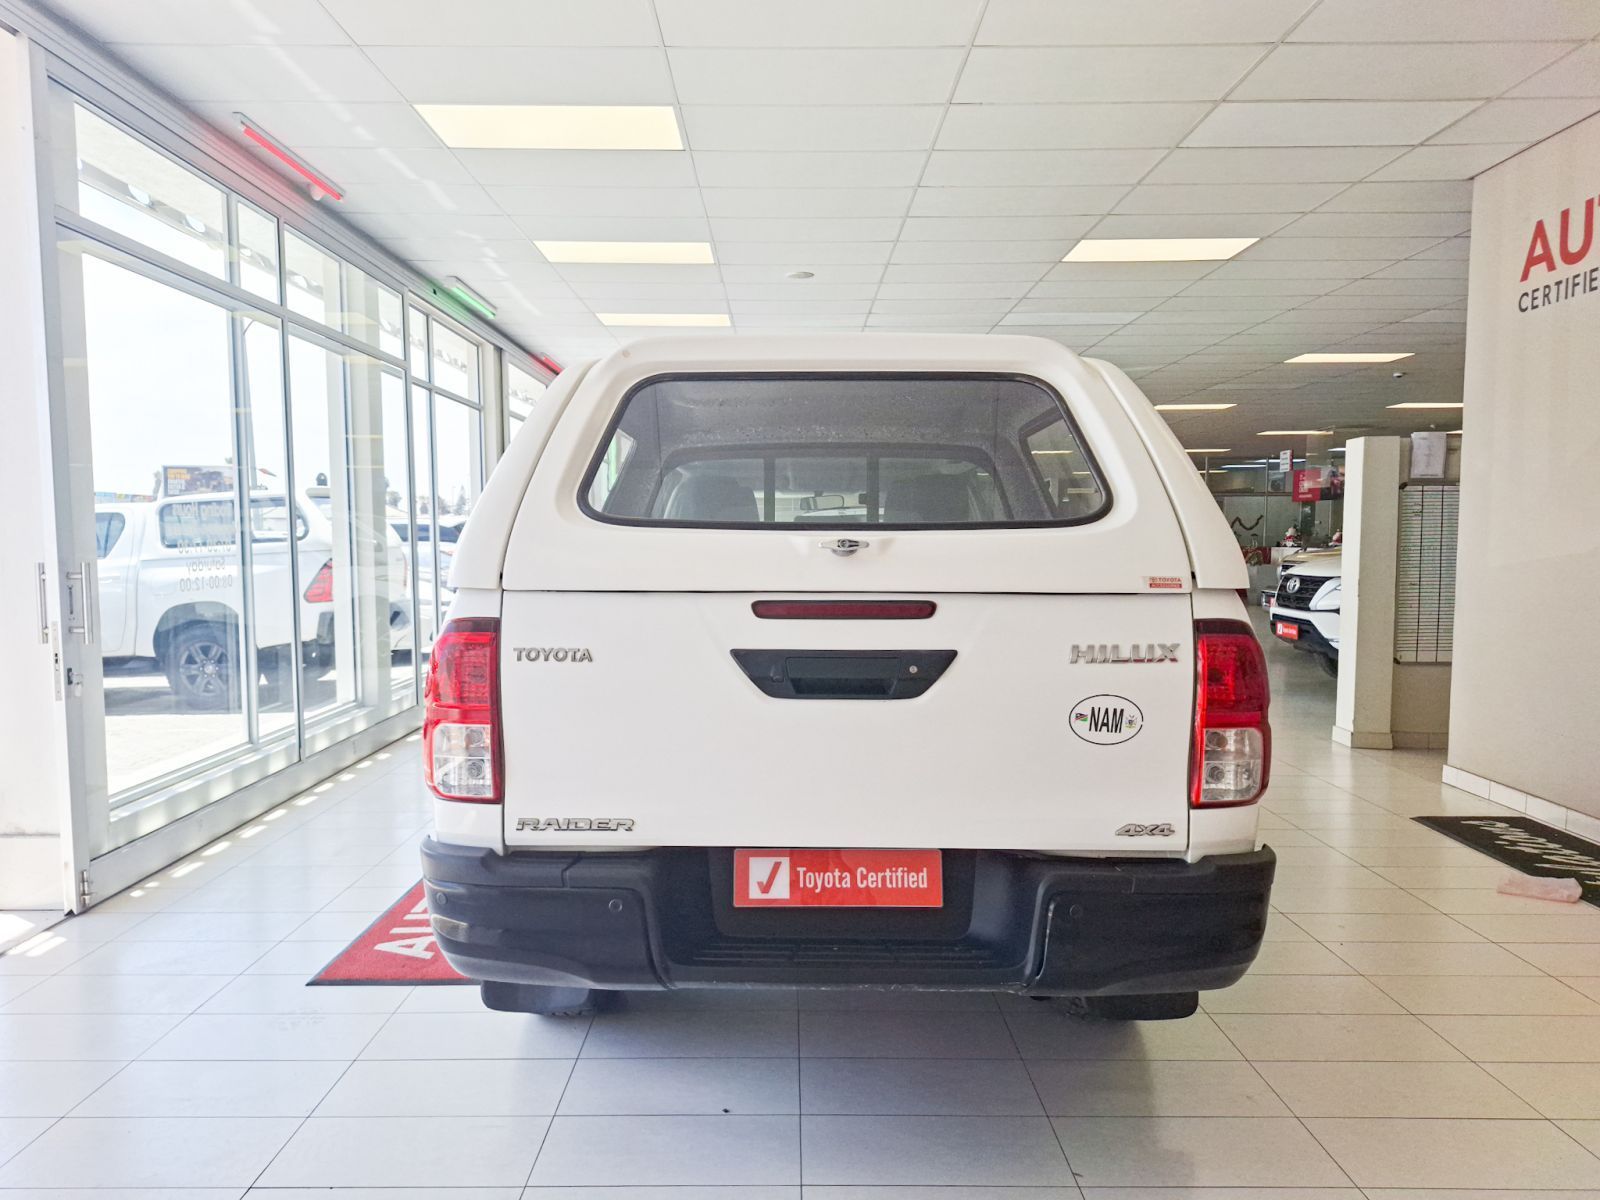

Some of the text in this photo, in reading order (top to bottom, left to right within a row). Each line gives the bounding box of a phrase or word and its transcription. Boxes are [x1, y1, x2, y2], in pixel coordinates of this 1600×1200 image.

[1520, 194, 1600, 283] AU
[513, 647, 593, 663] TOYOTA
[1070, 643, 1181, 664] HILUX
[1089, 706, 1125, 734] NAM
[516, 817, 635, 832] RAIDER
[796, 867, 928, 893] Toyota Certified
